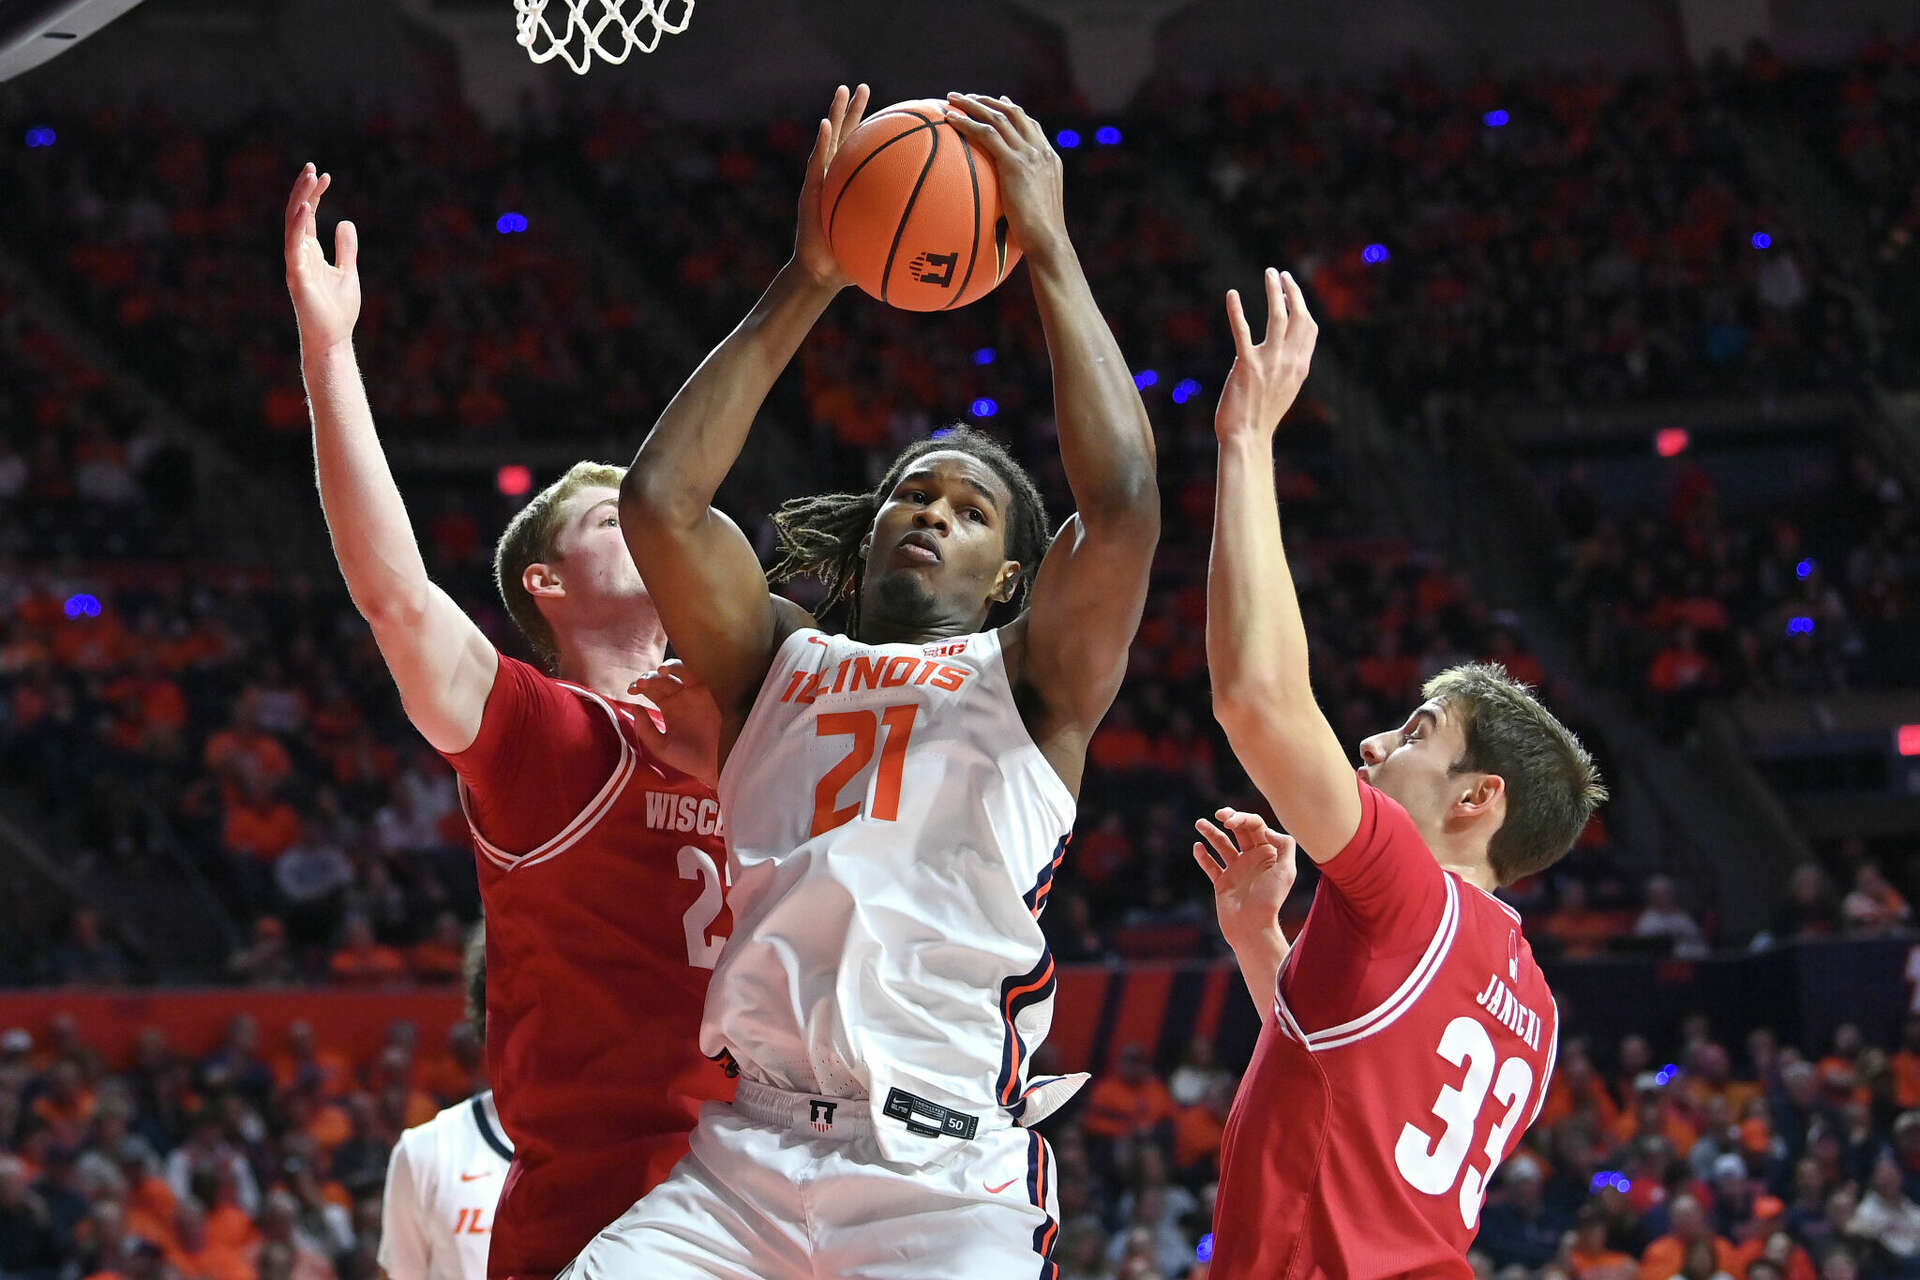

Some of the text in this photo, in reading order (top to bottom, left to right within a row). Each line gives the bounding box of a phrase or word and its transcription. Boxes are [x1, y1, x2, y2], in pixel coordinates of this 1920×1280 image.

[780, 656, 971, 704] ILLINOIS
[810, 703, 919, 838] 21
[677, 845, 732, 970] 2
[1476, 973, 1541, 1052] JANICKI
[948, 1117, 964, 1130] 50
[1394, 1016, 1533, 1230] 33
[455, 1208, 492, 1235] IL
